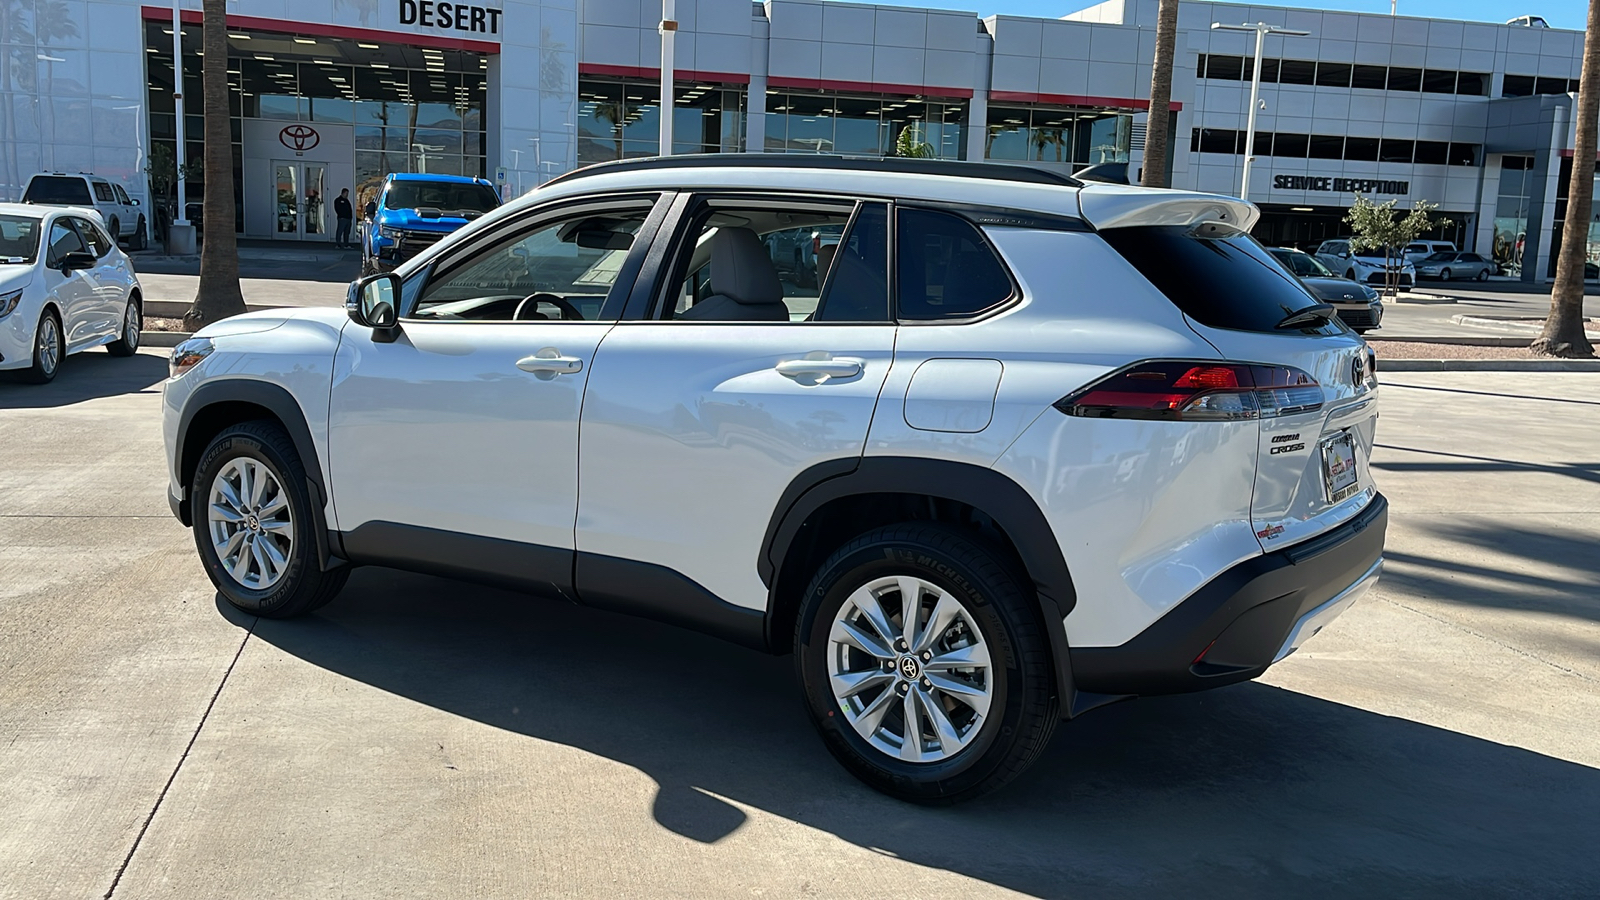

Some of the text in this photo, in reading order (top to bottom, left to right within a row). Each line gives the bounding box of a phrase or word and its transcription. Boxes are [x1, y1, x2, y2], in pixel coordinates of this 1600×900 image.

[400, 0, 502, 34] DESERT
[1273, 175, 1409, 195] SERVICE RECEPTION
[1270, 442, 1305, 455] CROSS
[917, 555, 984, 605] MICHELIN
